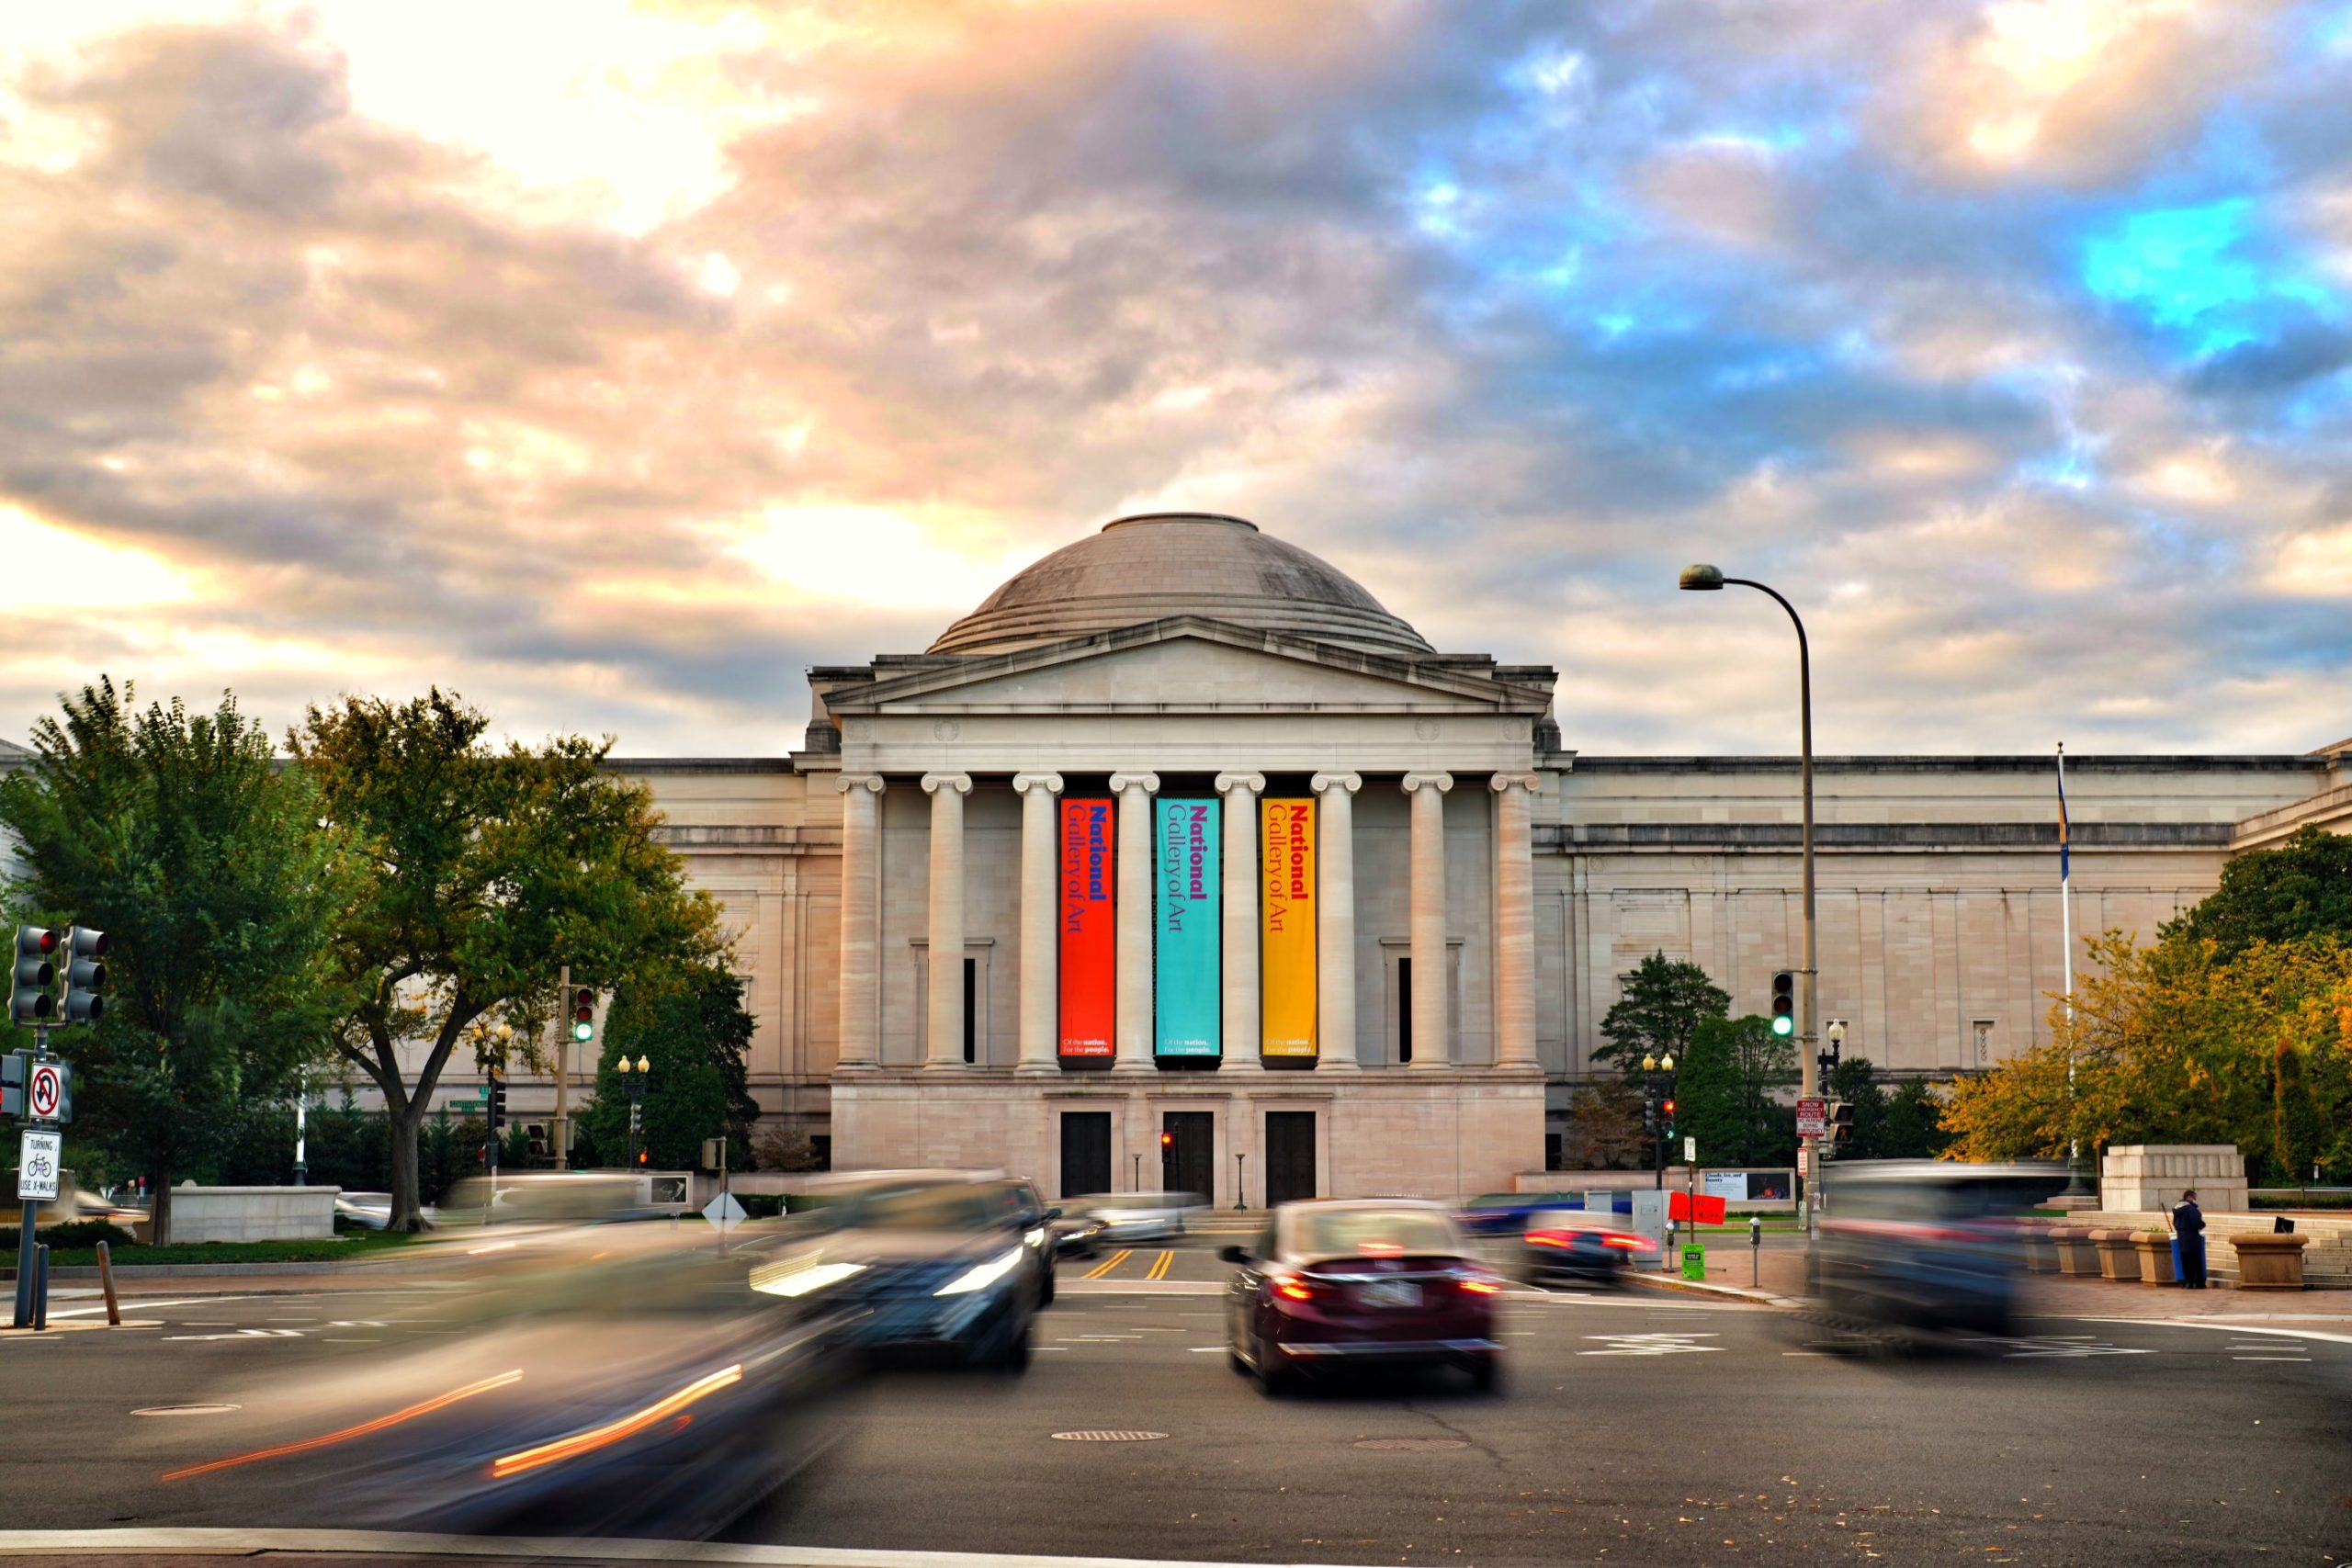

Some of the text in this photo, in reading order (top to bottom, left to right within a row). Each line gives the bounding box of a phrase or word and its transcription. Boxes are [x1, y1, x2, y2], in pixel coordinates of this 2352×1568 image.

[1064, 805, 1086, 932] Gallery of Art
[1090, 806, 1108, 900] National
[1164, 804, 1186, 933] Gallery of Art
[1190, 805, 1208, 900] National
[1265, 804, 1287, 933] Gallery of Art
[1290, 805, 1309, 900] National
[21, 1179, 56, 1191] USE X-WALKS
[30, 1139, 52, 1151] TURNING
